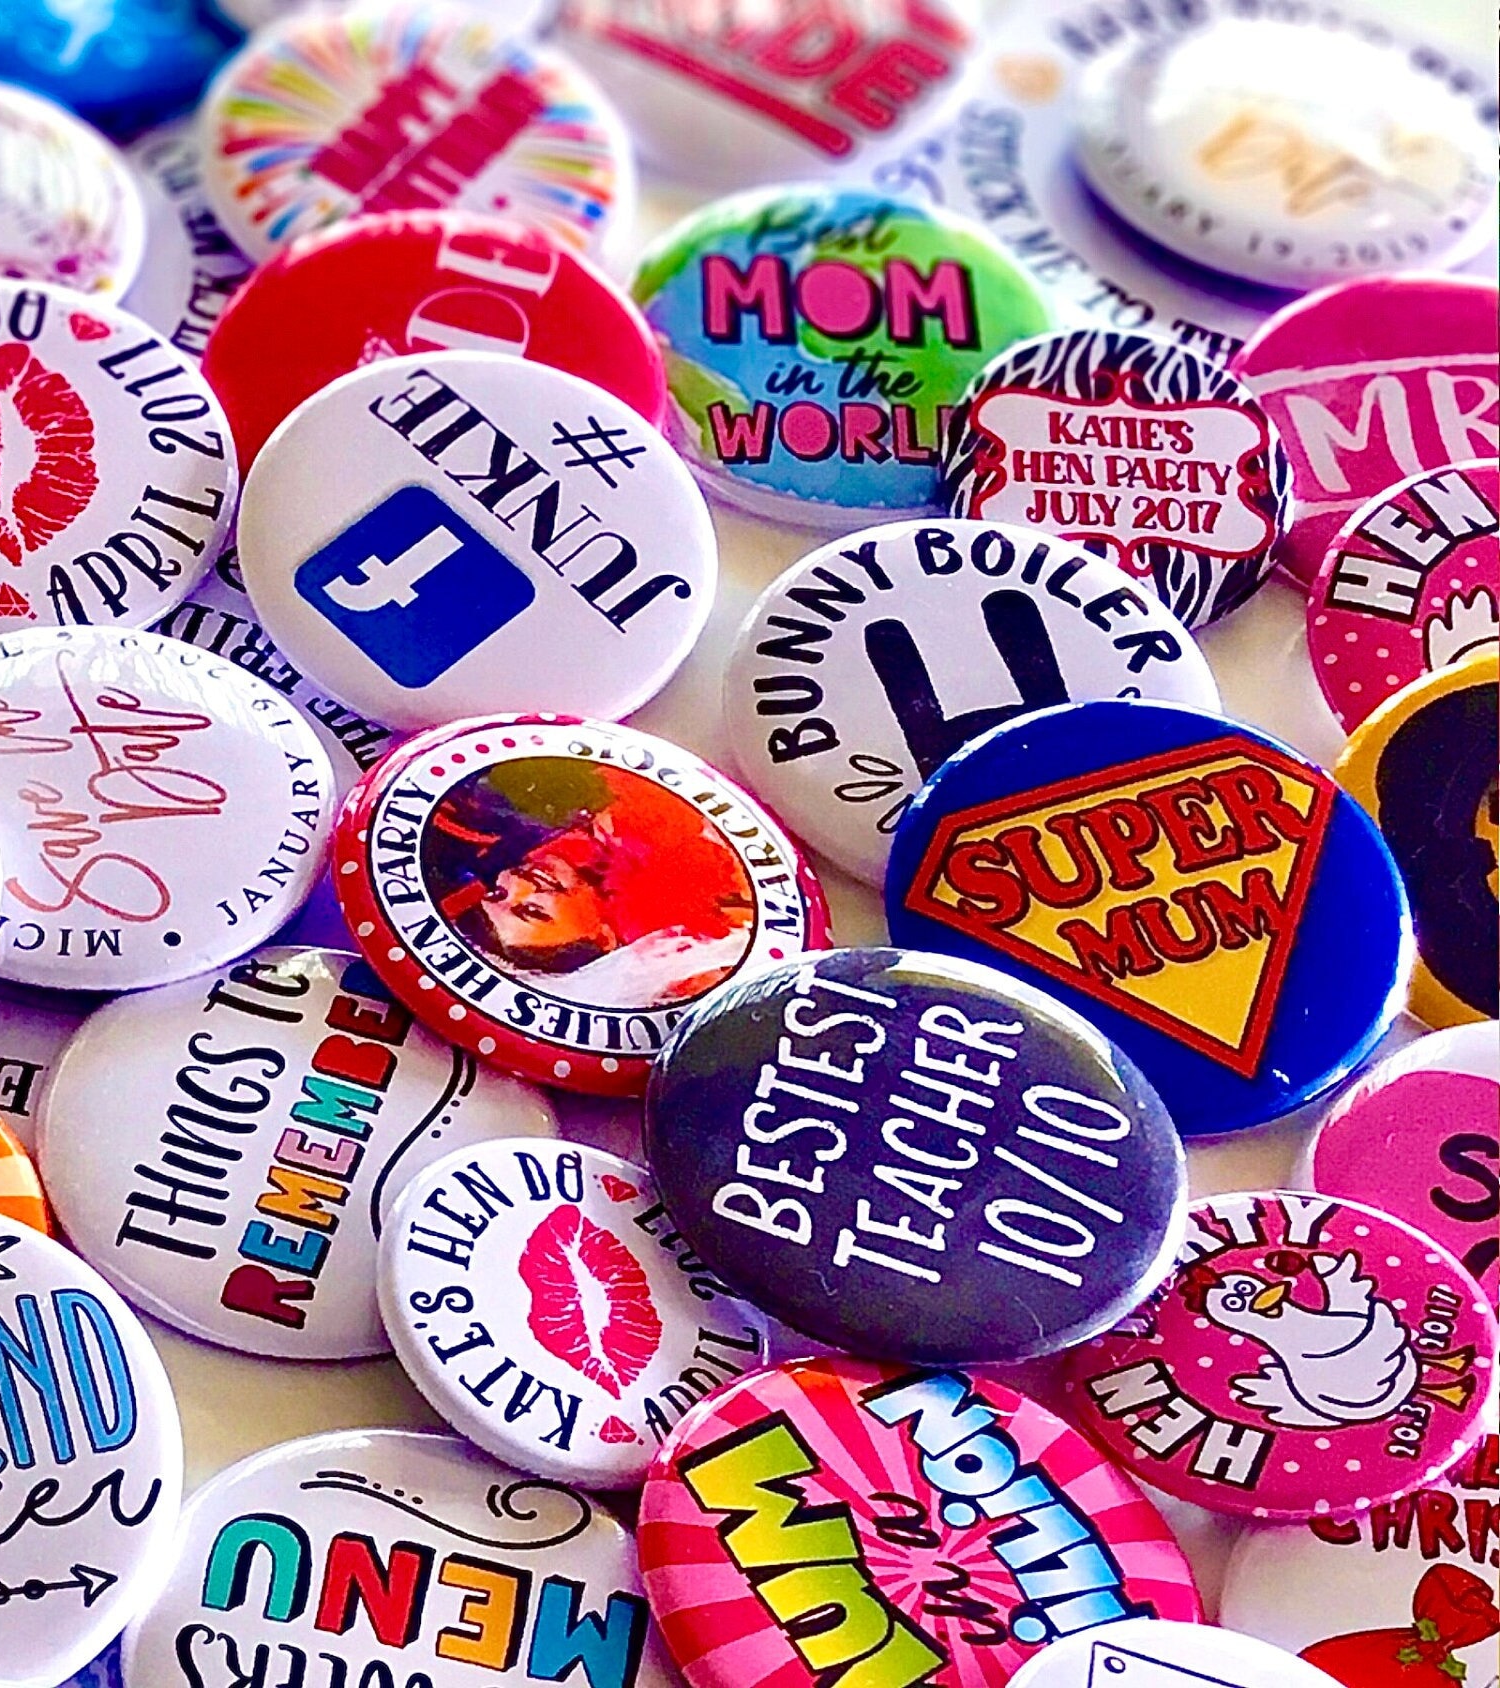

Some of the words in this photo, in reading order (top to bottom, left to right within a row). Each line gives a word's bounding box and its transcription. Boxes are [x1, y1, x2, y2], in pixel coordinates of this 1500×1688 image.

[747, 203, 900, 252] Best
[702, 253, 981, 351] MOM
[1085, 279, 1155, 329] TO
[1171, 318, 1247, 370] TH
[98, 336, 226, 461] 2017
[765, 361, 827, 398] in
[832, 351, 924, 400] the
[1048, 411, 1194, 454] KATIE'S
[368, 368, 692, 634] JUNKIE
[1012, 450, 1096, 487] HEN
[1105, 455, 1233, 495] PARTY
[1026, 490, 1122, 526] JULY
[1133, 496, 1222, 534] 2017
[46, 485, 226, 625] APRIL
[1325, 468, 1499, 622] HEN
[753, 541, 894, 765] BUNNY
[914, 527, 1184, 674] BOILER
[55, 648, 228, 824] Date
[6, 780, 172, 924] Save
[216, 750, 322, 928] JANUARY
[376, 777, 437, 910] PARTY
[692, 791, 802, 940] MARCH
[942, 762, 1306, 930] SUPER
[401, 914, 502, 1003] HEN
[1057, 867, 1286, 983] MUM
[711, 964, 898, 1246] BESTEST
[833, 1003, 1026, 1284] TEACHER
[407, 1162, 514, 1271] HEN
[514, 1151, 584, 1202] DO
[977, 1084, 1132, 1287] 10/10
[410, 1285, 583, 1451] KATE'S
[1084, 1359, 1276, 1491] HEN
[201, 1512, 648, 1688] MENU
